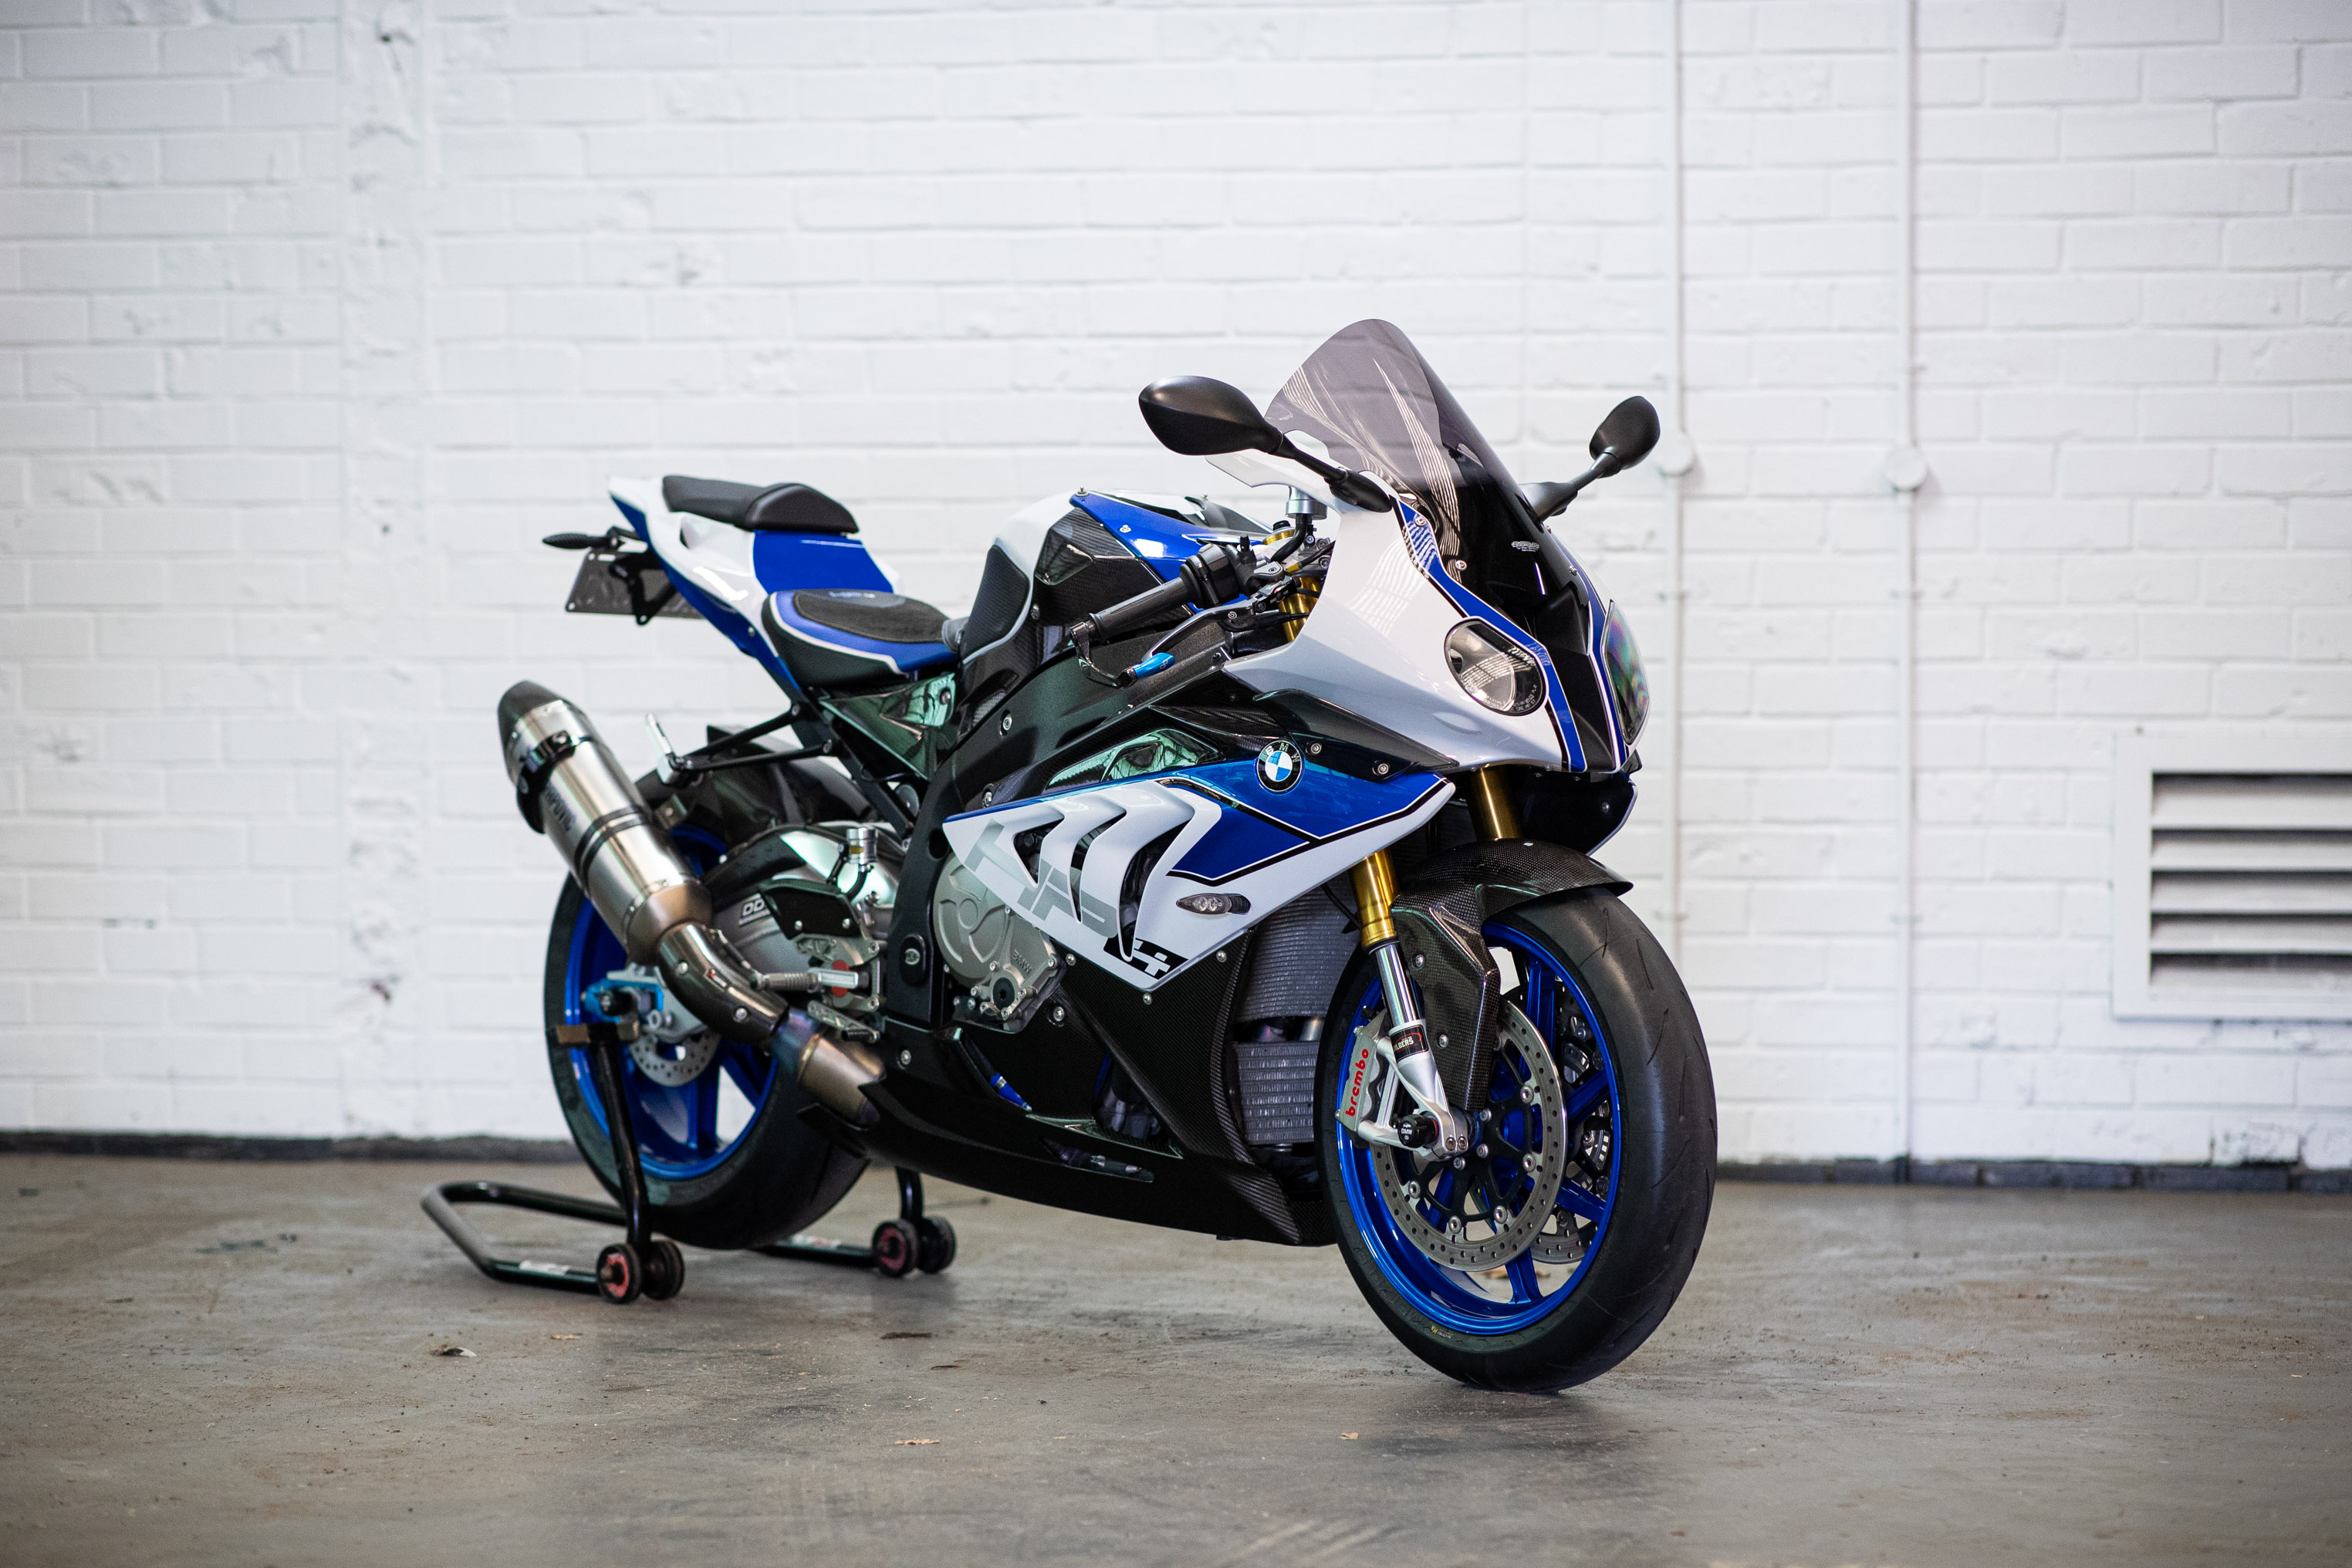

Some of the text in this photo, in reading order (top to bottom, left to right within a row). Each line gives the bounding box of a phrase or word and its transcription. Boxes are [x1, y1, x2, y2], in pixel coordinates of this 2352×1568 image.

[1266, 742, 1300, 762] BMW
[742, 899, 766, 916] DD
[1013, 950, 1032, 974] BMW
[1393, 1038, 1414, 1051] ILBERS
[1345, 1049, 1369, 1117] brembo
